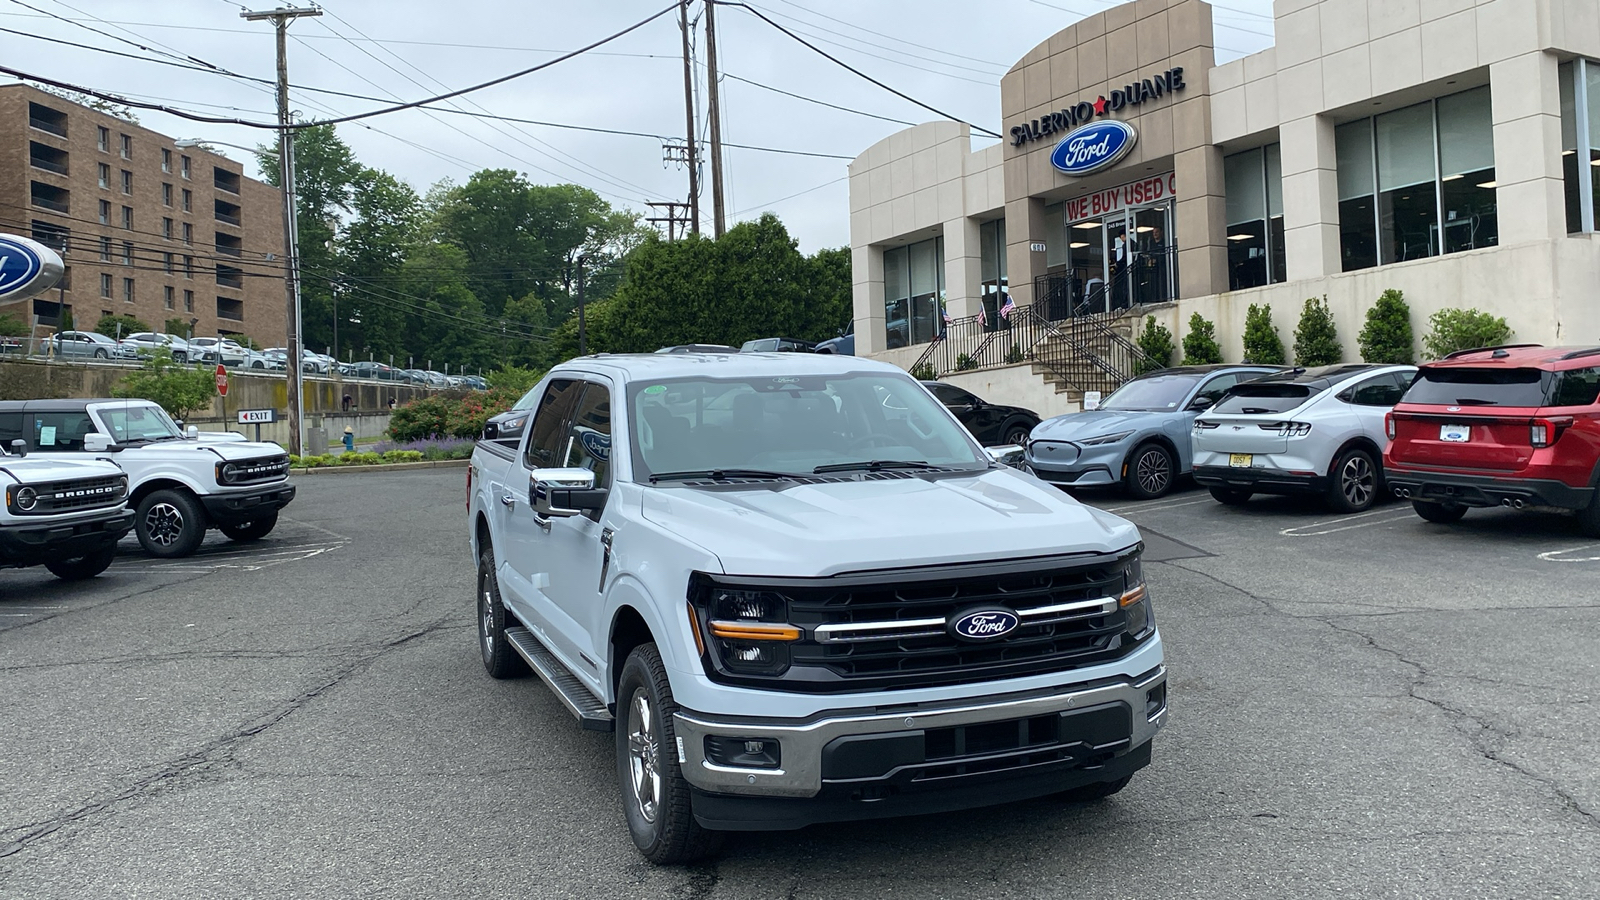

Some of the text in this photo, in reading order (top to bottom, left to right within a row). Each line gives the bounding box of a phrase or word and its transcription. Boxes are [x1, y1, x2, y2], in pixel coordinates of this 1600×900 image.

[1010, 66, 1186, 147] SALERNO DUANE
[1065, 132, 1110, 167] Ford
[1067, 197, 1089, 221] WE
[1092, 188, 1120, 215] BUY
[1124, 177, 1164, 206] USED
[216, 374, 227, 387] STOP
[250, 411, 268, 420] EXIT
[247, 464, 283, 473] BRONCO
[55, 486, 114, 499] BRONCO
[967, 614, 1007, 635] Ford
